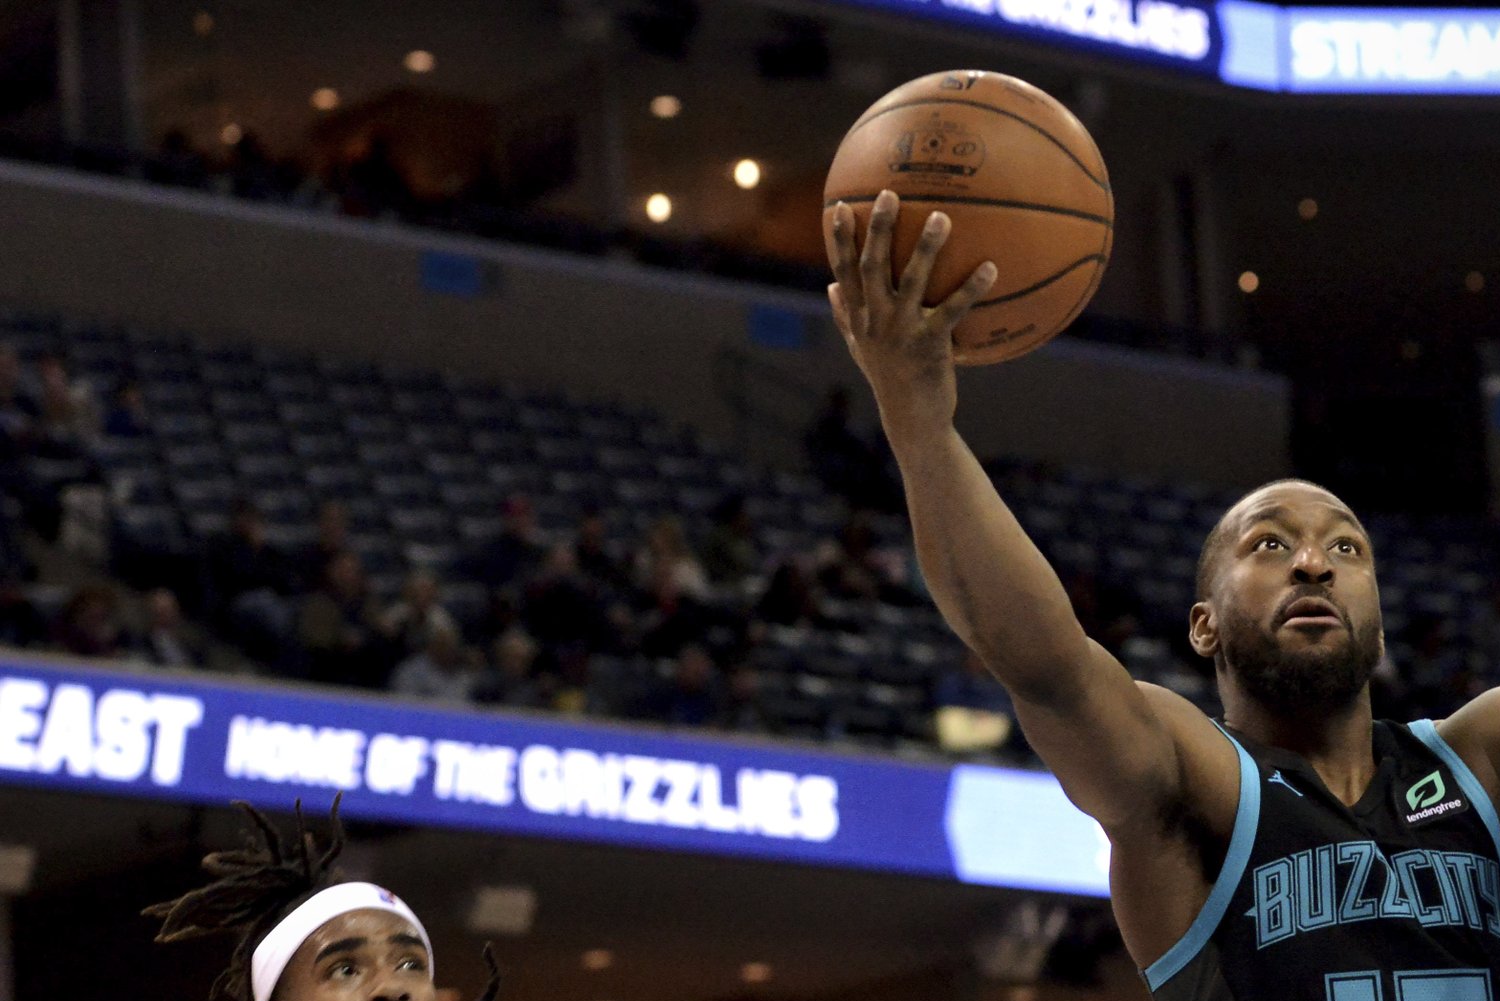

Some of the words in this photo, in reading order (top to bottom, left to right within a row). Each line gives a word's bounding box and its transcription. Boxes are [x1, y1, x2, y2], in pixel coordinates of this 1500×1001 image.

[0, 676, 204, 787] EAST
[223, 713, 367, 787] HOME
[365, 730, 431, 796] OF
[431, 738, 518, 805] THE
[518, 744, 841, 843] GRIZZLIES
[1406, 799, 1462, 823] lendingtree
